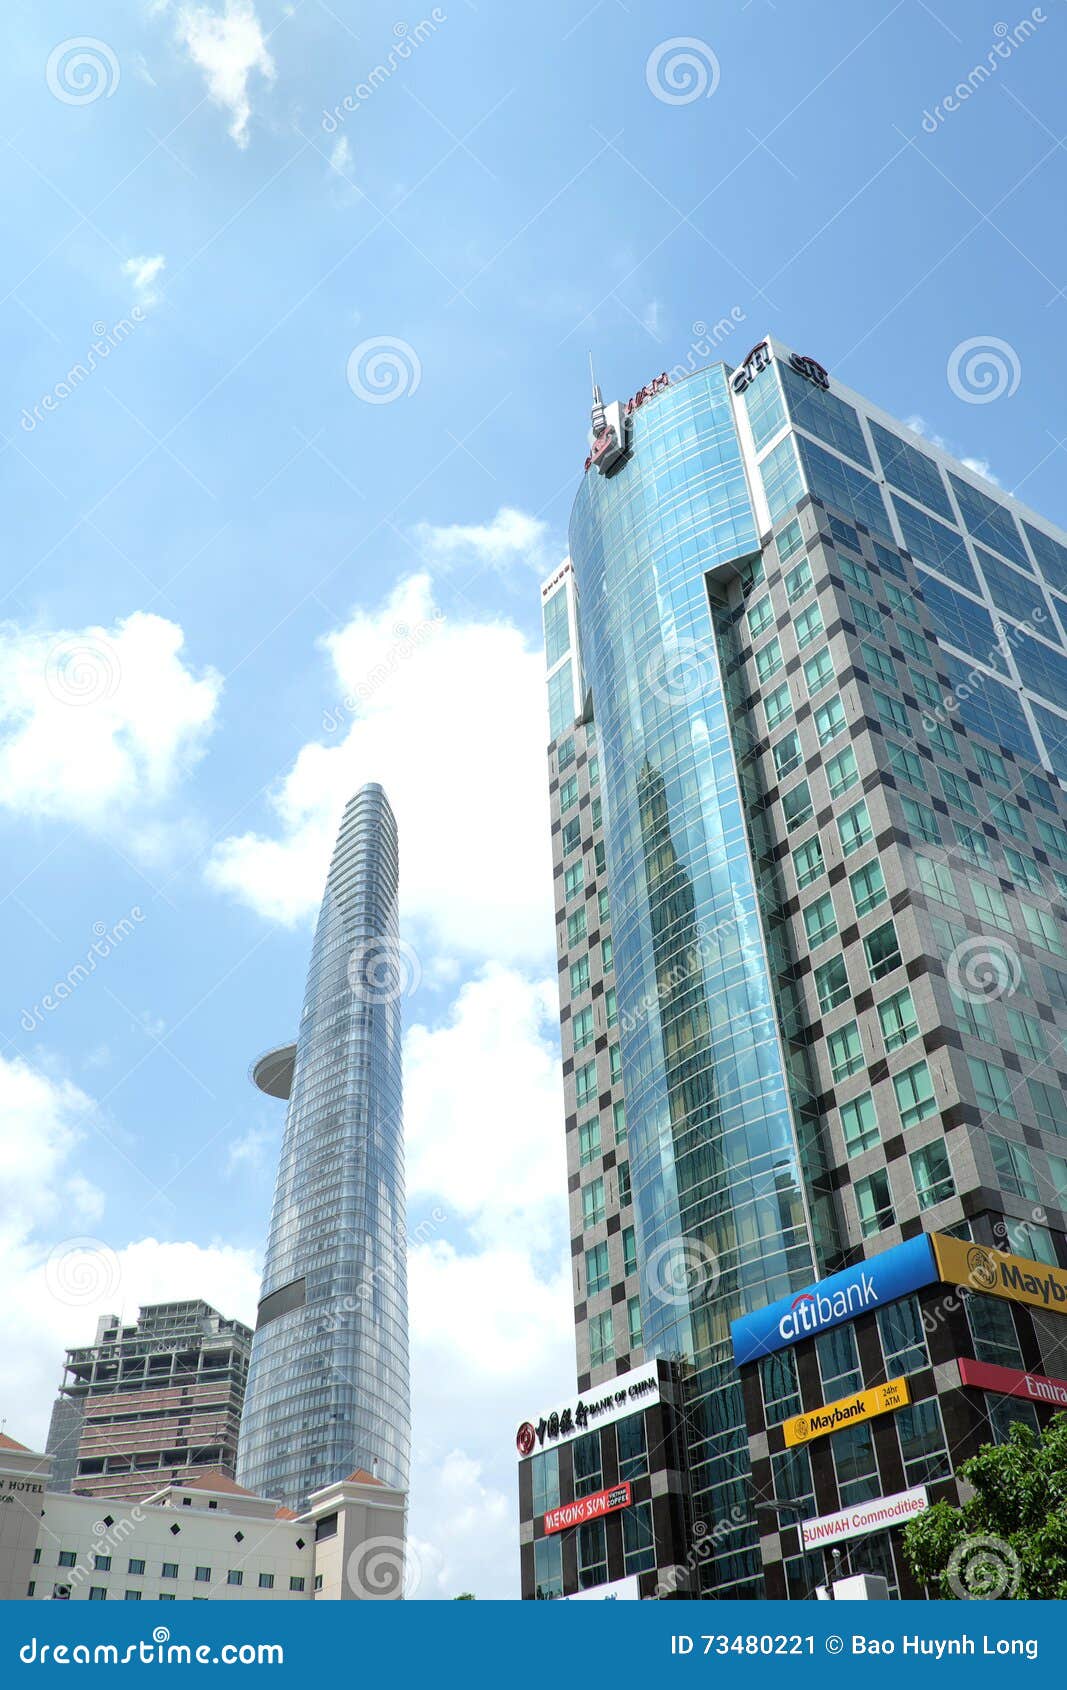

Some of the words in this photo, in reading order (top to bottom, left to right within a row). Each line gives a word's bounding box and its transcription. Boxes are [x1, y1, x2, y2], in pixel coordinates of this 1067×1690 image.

[778, 1272, 878, 1340] citibank
[589, 1394, 614, 1415] BANK
[614, 1388, 627, 1403] OF
[628, 1376, 658, 1397] CHINA
[882, 1385, 898, 1398] 24hr
[884, 1395, 901, 1408] ATM
[810, 1400, 866, 1431] Maybank
[9, 1481, 44, 1493] HOTEL
[545, 1503, 585, 1529] MEKONG
[586, 1495, 606, 1517] SUN
[803, 1517, 850, 1542] SUNWAH
[852, 1497, 925, 1527] Commodities
